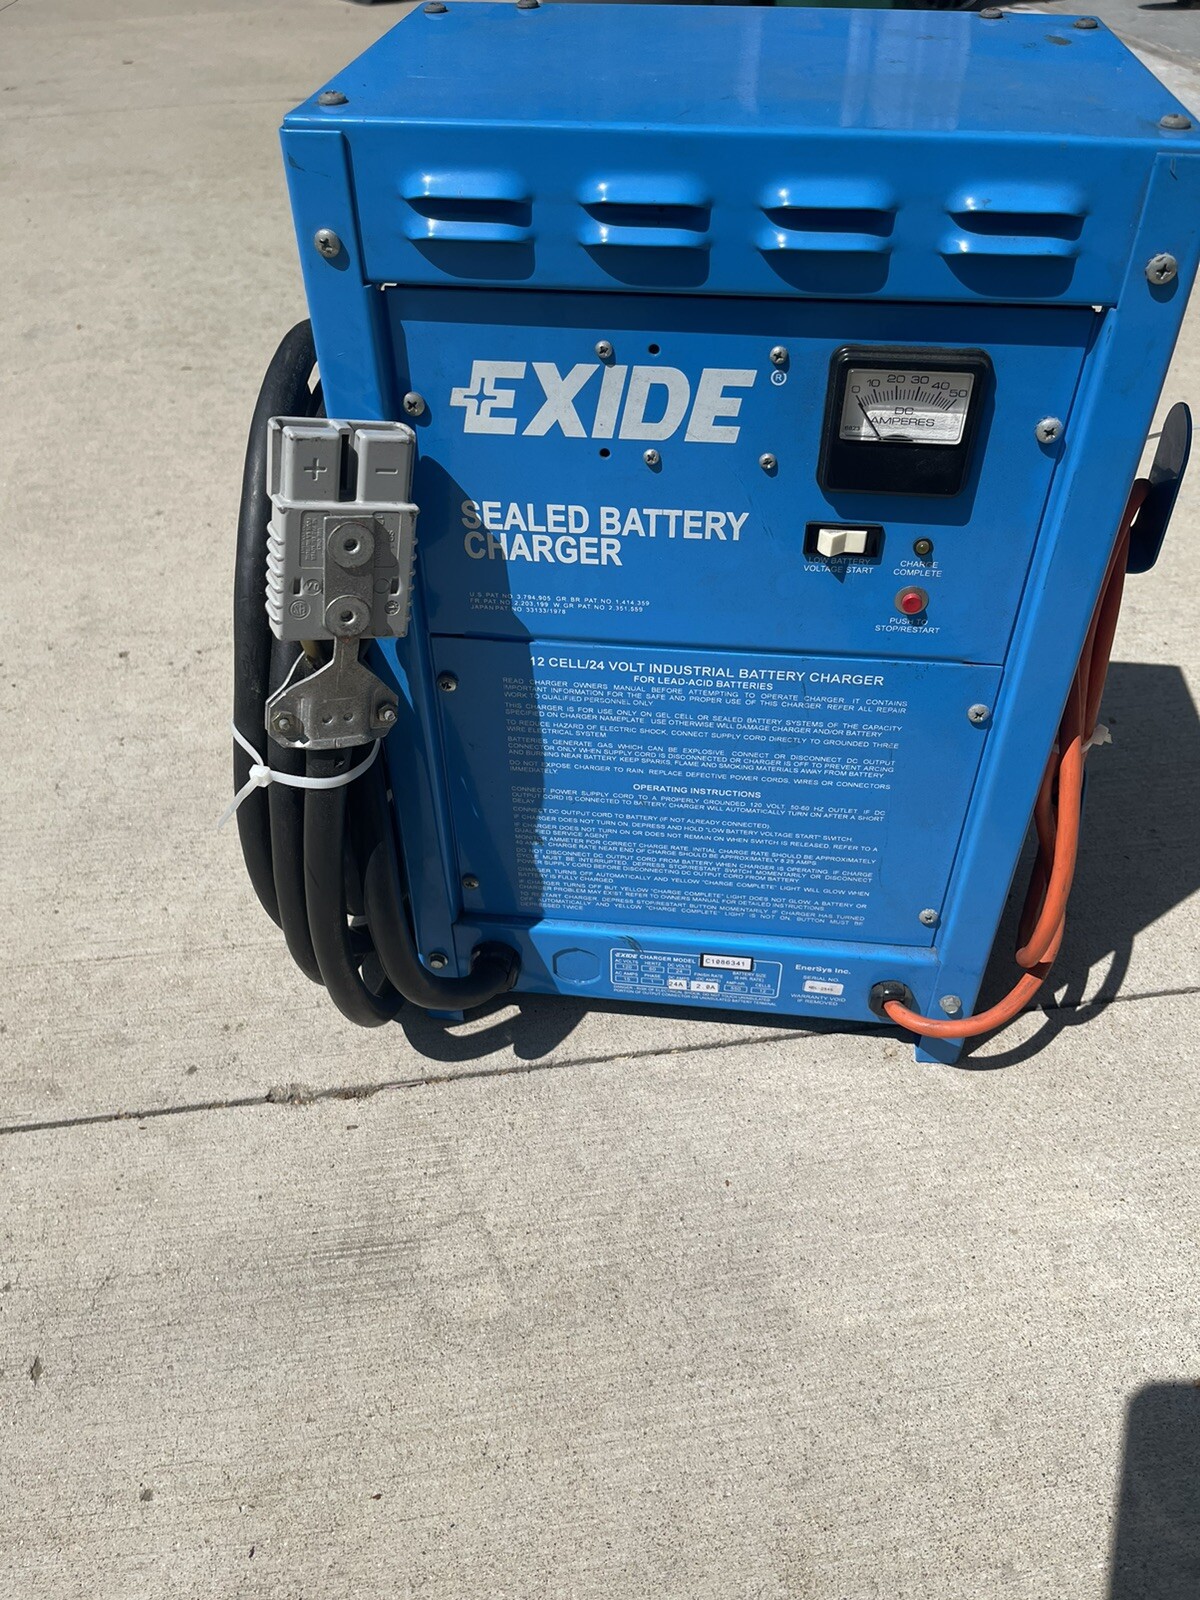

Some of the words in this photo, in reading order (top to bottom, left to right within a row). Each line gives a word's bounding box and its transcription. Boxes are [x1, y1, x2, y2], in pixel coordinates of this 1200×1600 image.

[866, 379, 881, 388] 10
[886, 374, 906, 384] 20
[910, 375, 930, 385] 30
[851, 385, 861, 394] 0
[931, 381, 950, 390] 40
[948, 389, 968, 398] 50
[449, 360, 758, 444] EXIDE
[894, 407, 914, 415] DC
[870, 416, 935, 427] AMPERES
[461, 499, 590, 534] SEALED
[600, 506, 750, 541] BATTERY
[463, 531, 623, 567] CHARGER
[808, 556, 829, 565] LOW
[830, 557, 871, 566] BATTERY
[900, 560, 939, 569] CHARGE
[803, 565, 843, 574] VOLTAGE
[845, 566, 874, 575] START
[893, 568, 943, 578] COMPLETE
[889, 617, 914, 626] PUSH
[915, 618, 929, 626] TO
[874, 624, 941, 634] STOP/RESTART
[530, 655, 544, 667] 12
[548, 656, 604, 670] CELL/24
[608, 660, 643, 672] VOLT
[648, 662, 734, 678] INDUSTRIAL
[738, 667, 805, 681] BATTERY
[808, 671, 884, 686] CHARGER
[632, 675, 655, 684] FOR
[657, 676, 713, 687] LEAD-ACID
[715, 679, 773, 690] BATTERIES
[540, 693, 583, 702] QUALIFIED
[582, 696, 631, 705] PERSONNEL
[572, 681, 608, 689] OWNERS
[612, 683, 645, 692] MANUAL
[650, 685, 683, 694] BEFORE
[688, 688, 739, 697] ATTEMPTING
[759, 692, 799, 700] OPERATE
[864, 698, 908, 706] CONTAINS
[549, 687, 604, 697] INFORMATION
[606, 690, 623, 698] FOR
[688, 695, 722, 703] PROPER
[724, 697, 742, 705] USE
[759, 699, 778, 707] THIS
[825, 703, 855, 711] REFER
[875, 706, 907, 714] REPAIR
[559, 712, 598, 720] CHARGER
[667, 718, 715, 727] OTHERWISE
[734, 722, 770, 730] DAMAGE
[770, 724, 811, 733] CHARGER
[812, 727, 845, 735] AND/OR
[577, 706, 594, 714] FOR
[711, 714, 744, 722] SEALED
[745, 716, 782, 725] BATTERY
[784, 719, 824, 727] SYSTEMS
[859, 723, 903, 732] CAPACITY
[552, 722, 585, 730] HAZARD
[599, 725, 638, 733] ELECTRIC
[670, 729, 708, 737] CONNECT
[710, 731, 742, 739] SUPPLY
[742, 733, 767, 741] CORD
[767, 735, 808, 743] DIRECTLY
[819, 738, 870, 747] GROUNDED
[871, 741, 899, 749] THREE
[551, 739, 592, 747] GENERATE
[617, 743, 643, 751] WHICH
[730, 750, 769, 758] CONNECT
[789, 754, 841, 763] DISCONNECT
[861, 758, 895, 766] OUTPUT
[573, 764, 610, 772] CHARGER
[648, 768, 683, 776] REPLACE
[684, 771, 727, 779] DEFECTIVE
[834, 780, 891, 789] CONNECTORS
[632, 783, 688, 793] OPERATING
[689, 787, 761, 798] INSTRUCTIONS
[547, 788, 577, 796] POWER
[580, 790, 608, 798] SUPPLY
[659, 796, 699, 804] PROPERLY
[702, 798, 746, 807] GROUNDED
[759, 830, 793, 838] VOLTAGE
[639, 954, 672, 962] CHARGER
[704, 958, 746, 967] C1086341
[795, 964, 832, 974] EnerSys
[834, 967, 851, 975] Inc.
[790, 993, 829, 1001] WARRANTY
